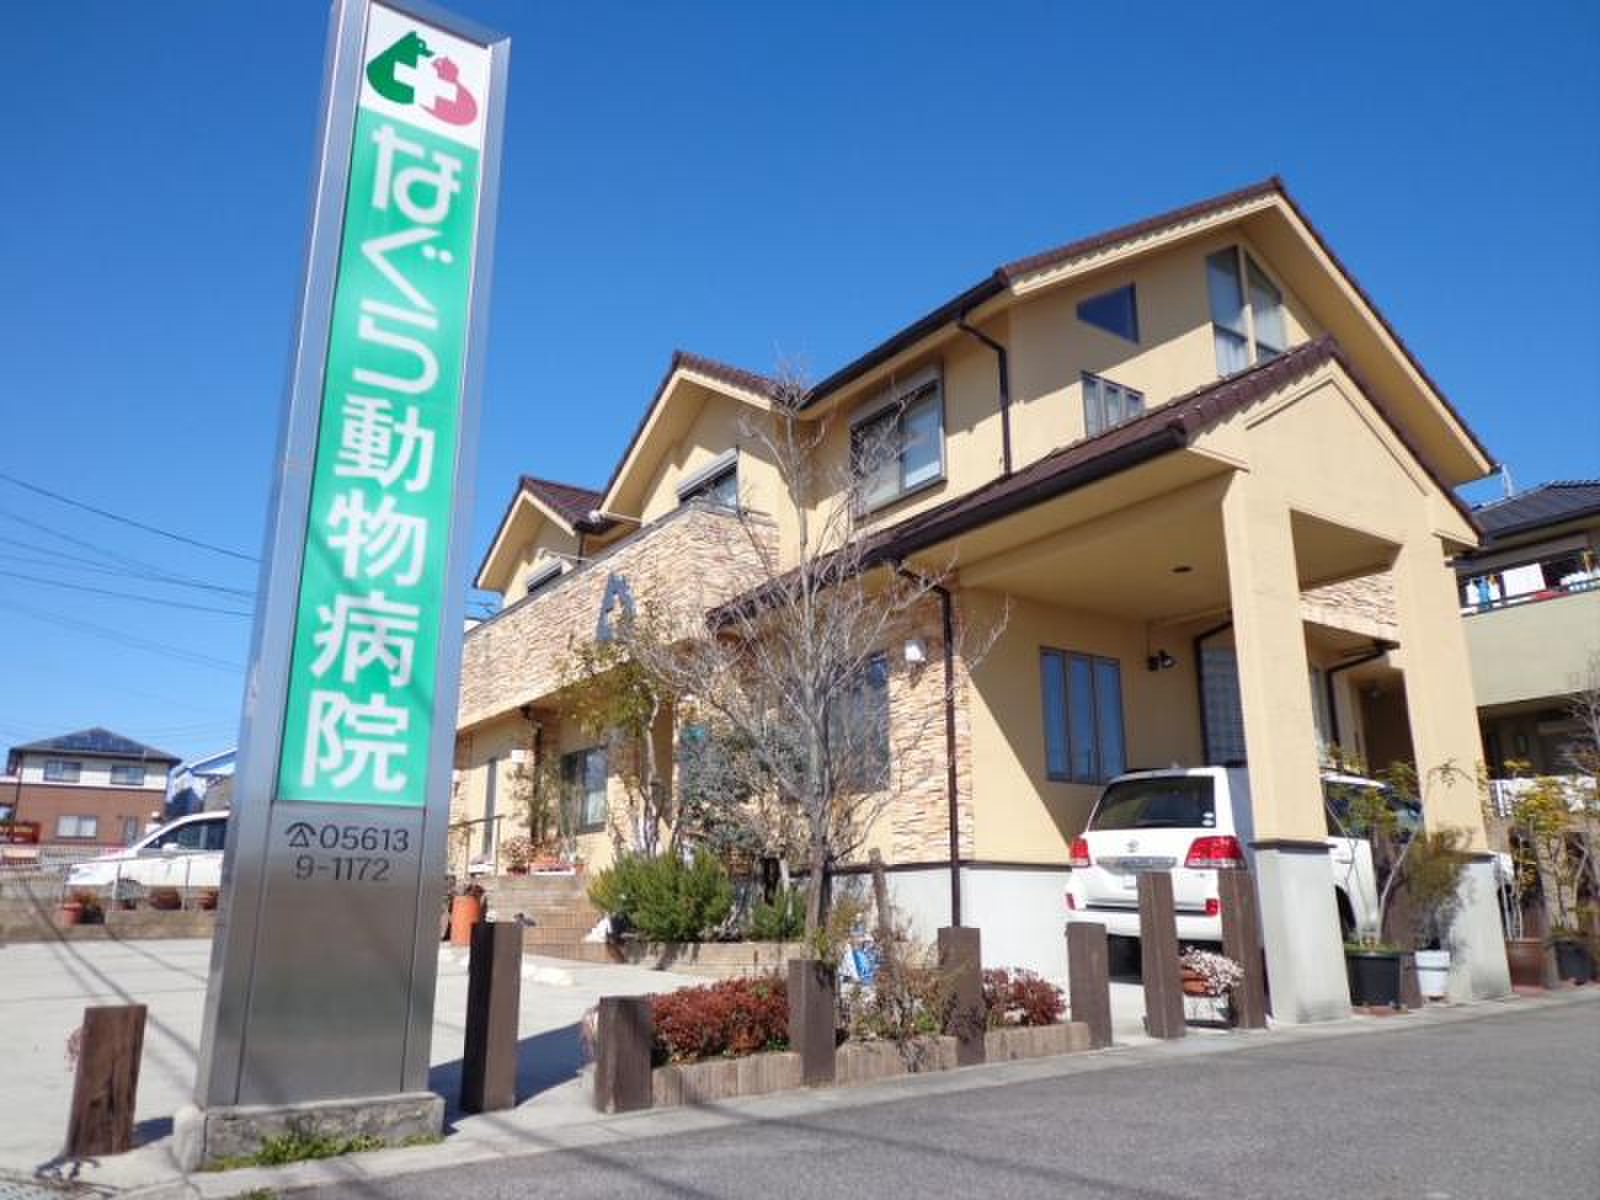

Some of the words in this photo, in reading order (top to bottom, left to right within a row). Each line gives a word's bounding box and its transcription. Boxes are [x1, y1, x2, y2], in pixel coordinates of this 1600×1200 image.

[301, 124, 462, 794] なぐら動物病院
[319, 823, 409, 852] 05613
[296, 854, 390, 881] 9-1172
